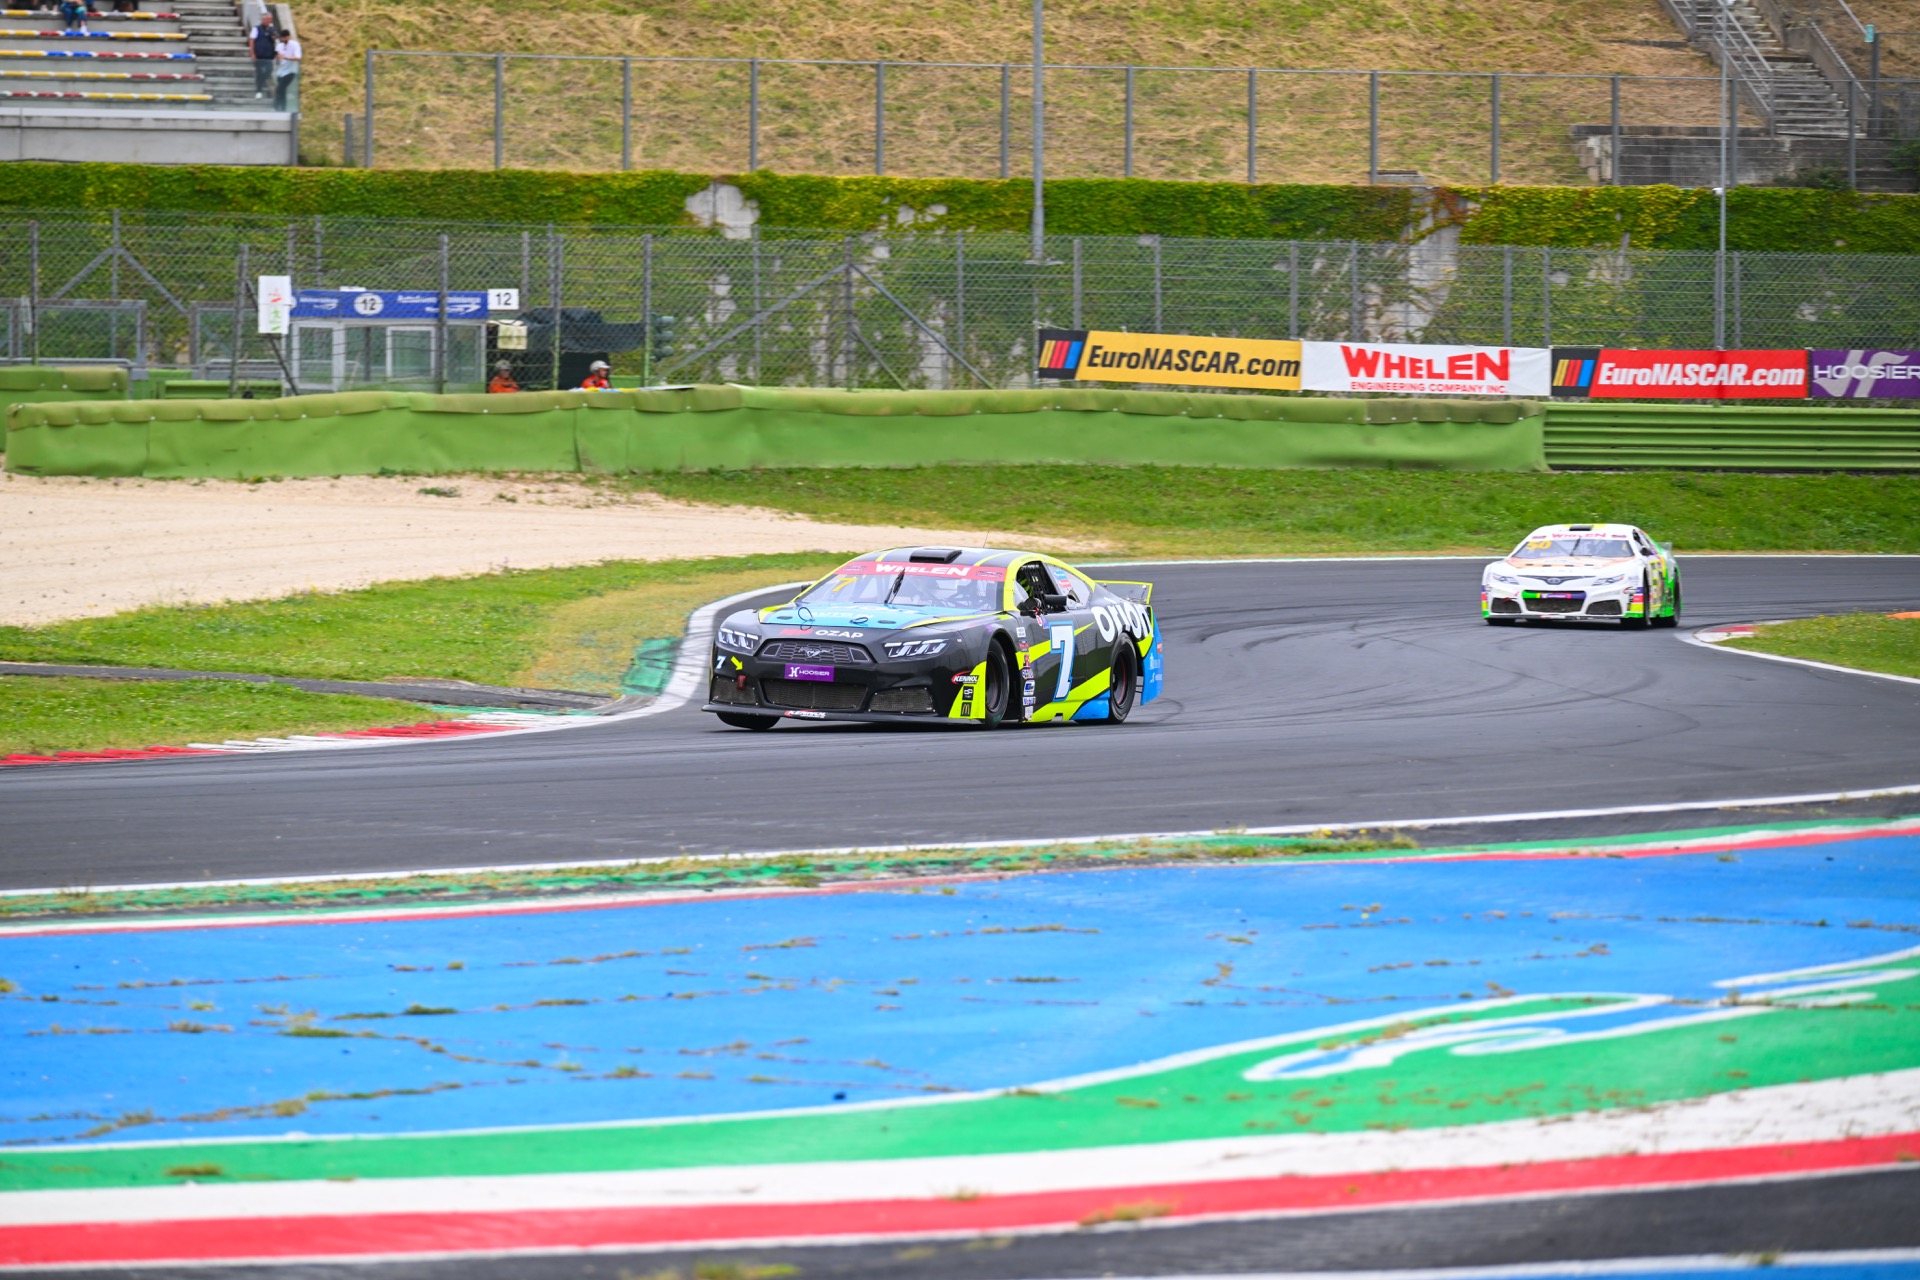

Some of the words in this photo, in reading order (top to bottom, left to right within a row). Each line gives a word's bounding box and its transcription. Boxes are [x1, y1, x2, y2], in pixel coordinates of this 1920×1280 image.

[495, 292, 512, 306] 12
[1087, 345, 1300, 377] EuroNASCAR.com
[1340, 345, 1510, 381] WHELEN
[1598, 362, 1804, 386] EuroNASCAR.com
[1813, 365, 1920, 379] HOOSIER
[1351, 381, 1426, 392] ENGINEERING
[1428, 383, 1483, 393] COMPANY
[875, 563, 971, 576] WHELEN
[832, 578, 857, 592] 7
[815, 629, 864, 639] OZAP
[716, 656, 726, 669] 7
[1050, 624, 1074, 700] 7
